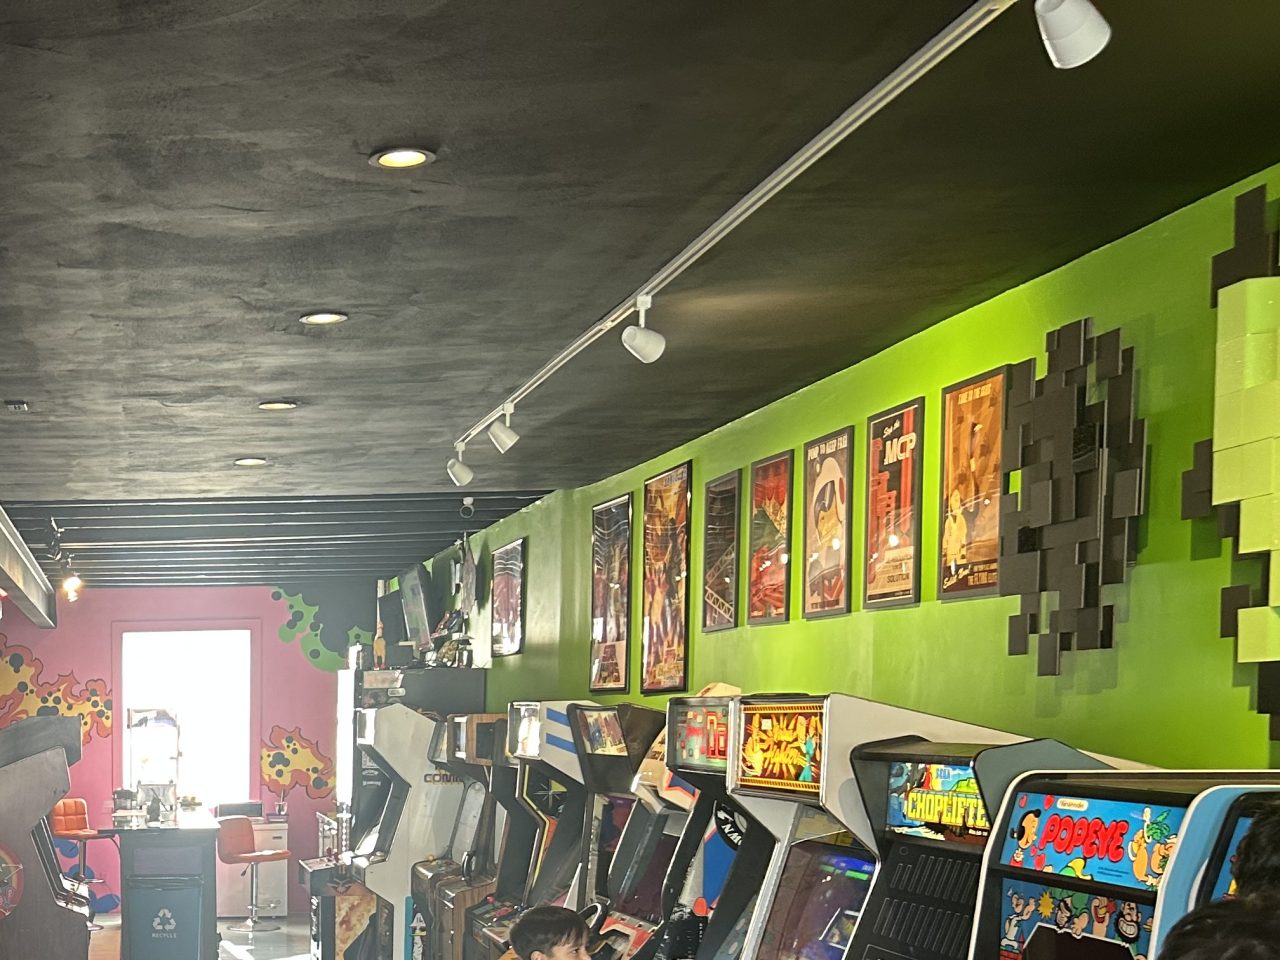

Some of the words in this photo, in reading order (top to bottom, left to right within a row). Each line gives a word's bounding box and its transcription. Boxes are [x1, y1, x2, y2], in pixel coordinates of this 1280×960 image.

[883, 432, 916, 465] MCP
[936, 767, 951, 780] SEGA
[907, 792, 988, 828] CHOPLIFTE
[1037, 812, 1130, 864] POPEYE
